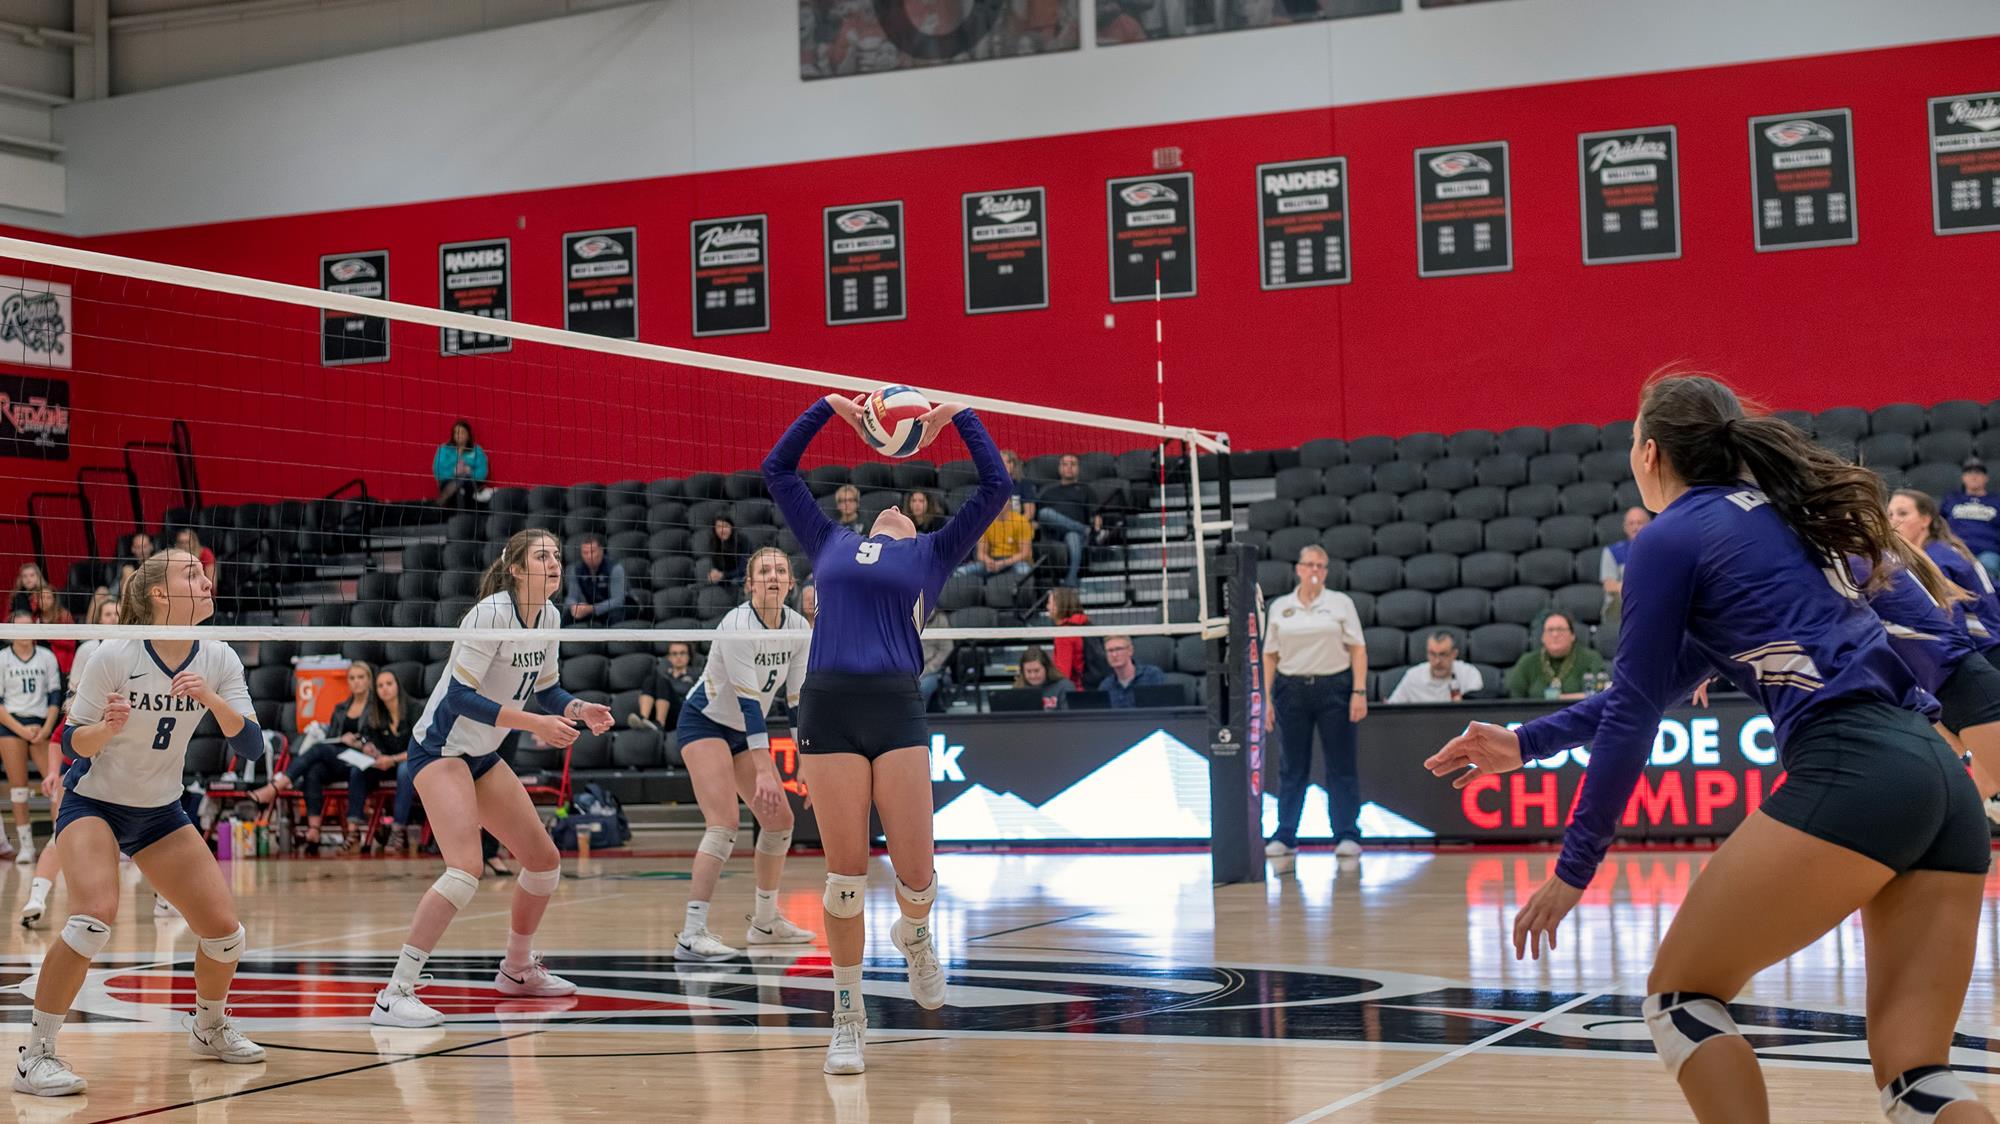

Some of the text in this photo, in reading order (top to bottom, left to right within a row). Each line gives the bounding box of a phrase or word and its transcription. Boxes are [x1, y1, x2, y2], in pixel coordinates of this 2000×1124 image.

[1265, 169, 1339, 196] RAIDERS
[445, 248, 504, 272] RAIDERS
[855, 542, 882, 564] 9
[22, 678, 36, 693] 16
[512, 671, 538, 700] 17
[761, 669, 777, 692] 6
[152, 717, 176, 750] 8
[1461, 769, 1788, 829] CHMPI
